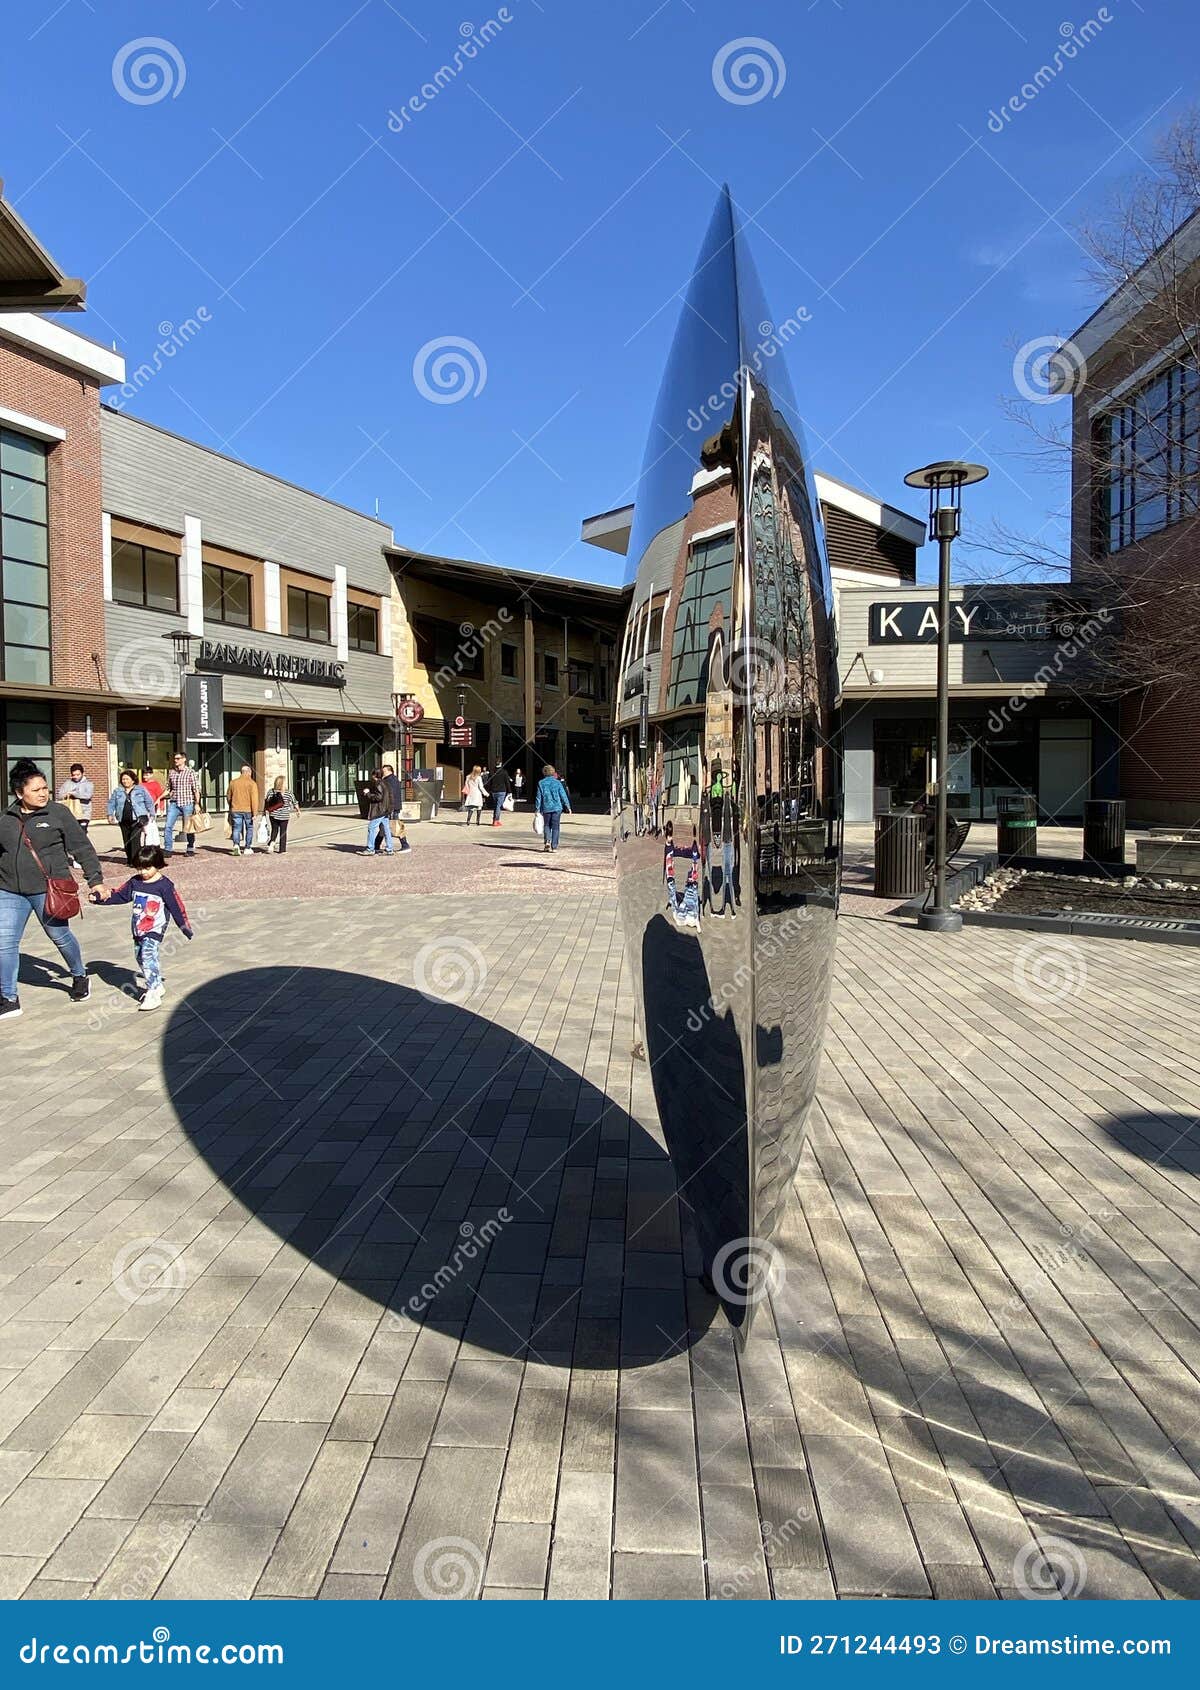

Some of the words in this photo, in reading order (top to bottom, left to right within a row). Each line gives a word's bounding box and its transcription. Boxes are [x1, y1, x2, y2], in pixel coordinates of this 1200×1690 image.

[880, 605, 980, 637] KAY
[1006, 624, 1062, 635] OUTLET
[201, 640, 274, 669] BANANA
[276, 652, 345, 679] REPUBLIC
[263, 668, 298, 679] FACTORY
[200, 703, 208, 730] OUTLET
